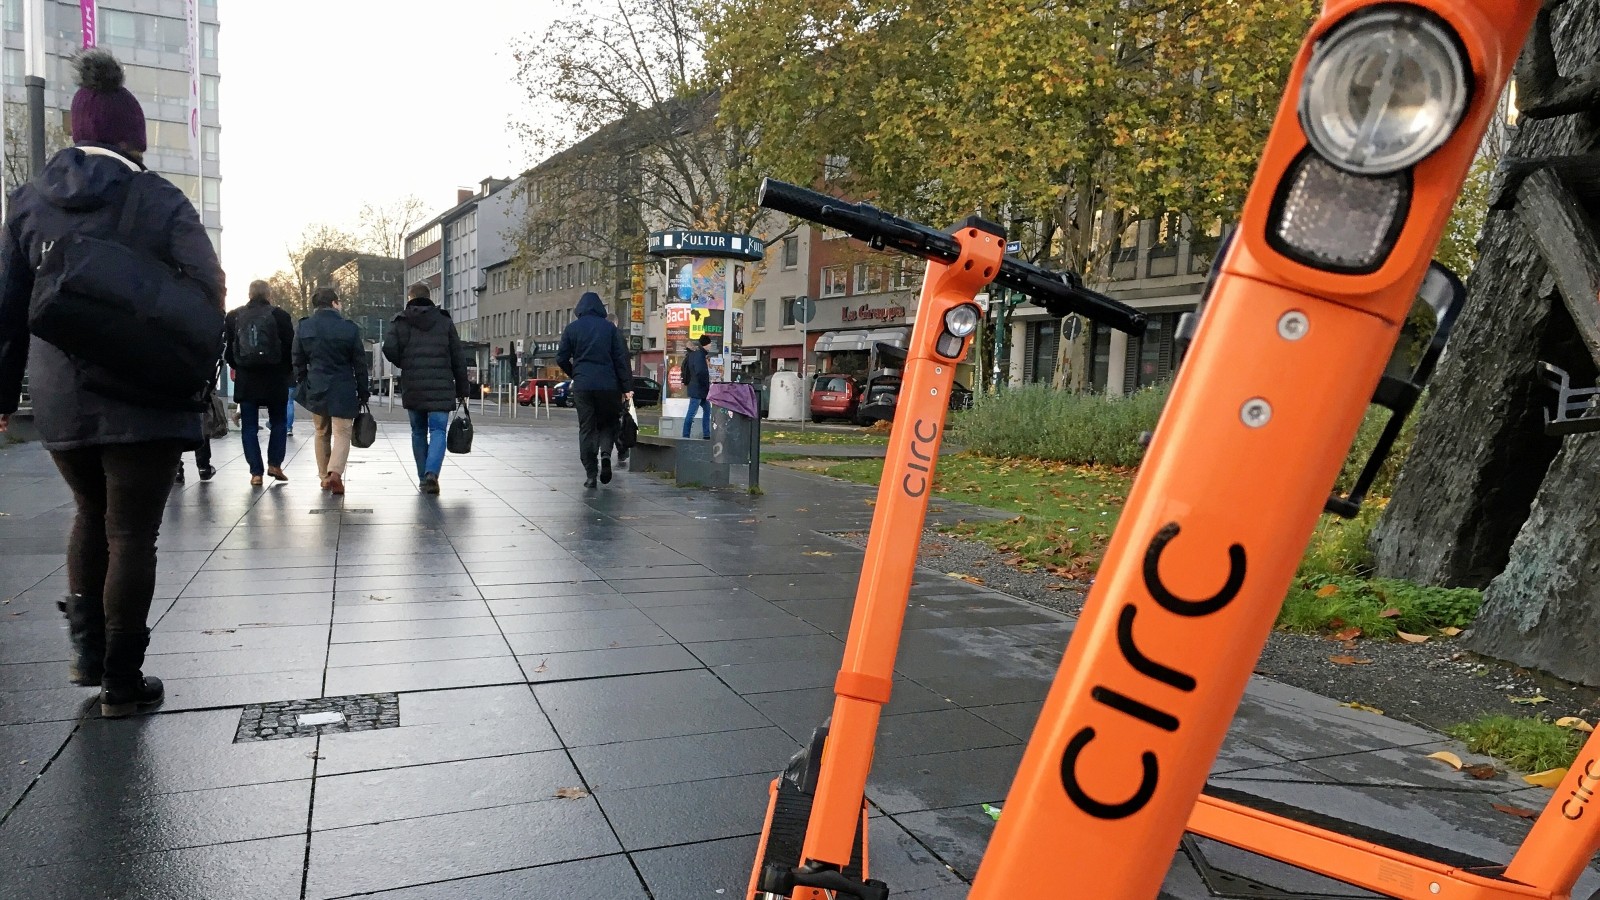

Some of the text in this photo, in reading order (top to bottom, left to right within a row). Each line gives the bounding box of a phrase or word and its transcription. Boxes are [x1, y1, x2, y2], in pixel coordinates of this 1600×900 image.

[681, 232, 725, 247] KULTUR
[666, 308, 691, 323] Bach
[692, 324, 722, 332] BENEFIZ
[903, 419, 937, 497] circ
[1061, 521, 1247, 820] circ
[1562, 759, 1600, 820] circ
